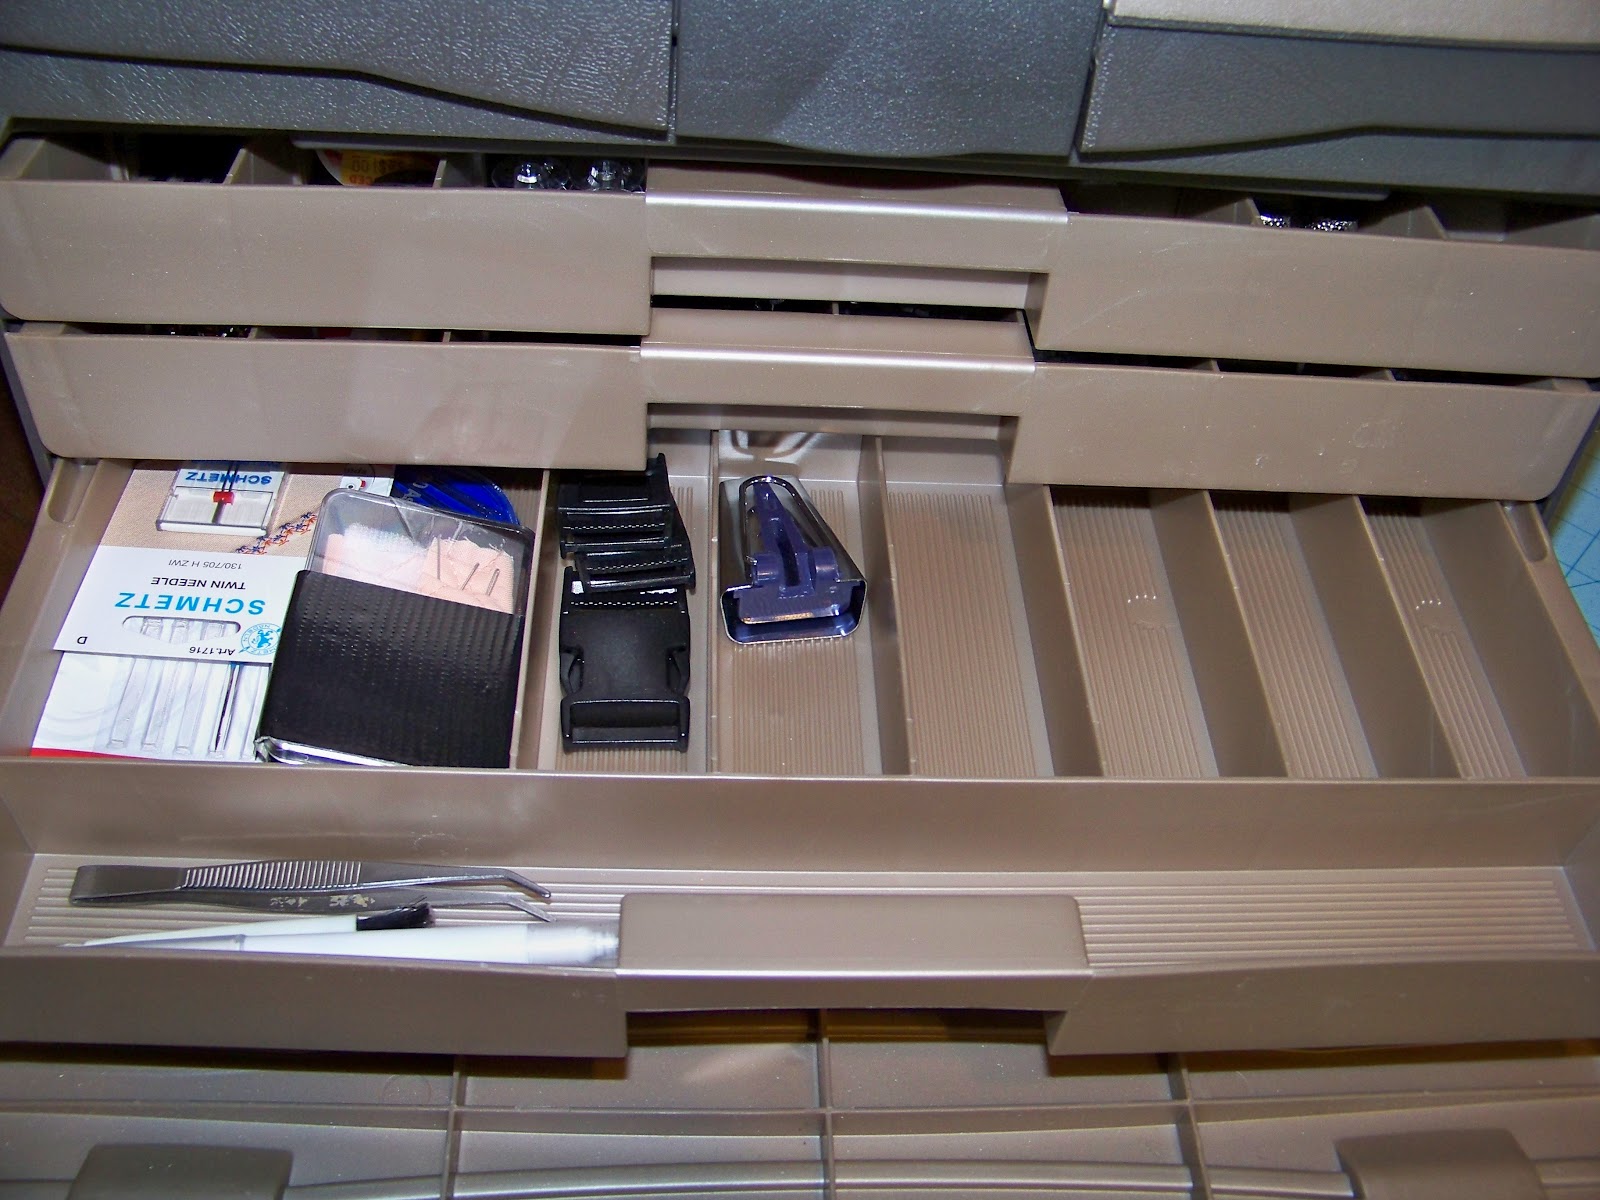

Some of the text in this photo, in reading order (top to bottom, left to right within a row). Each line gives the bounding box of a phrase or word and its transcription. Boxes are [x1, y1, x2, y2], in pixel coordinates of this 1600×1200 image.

[185, 471, 272, 485] SCHMETZ
[169, 559, 189, 567] ZWI
[203, 561, 242, 570] 130/705
[151, 576, 246, 590] TWIN NEEDLE
[115, 592, 266, 615] SCHMETZ
[77, 635, 88, 645] D
[189, 646, 236, 656] Art.1716
